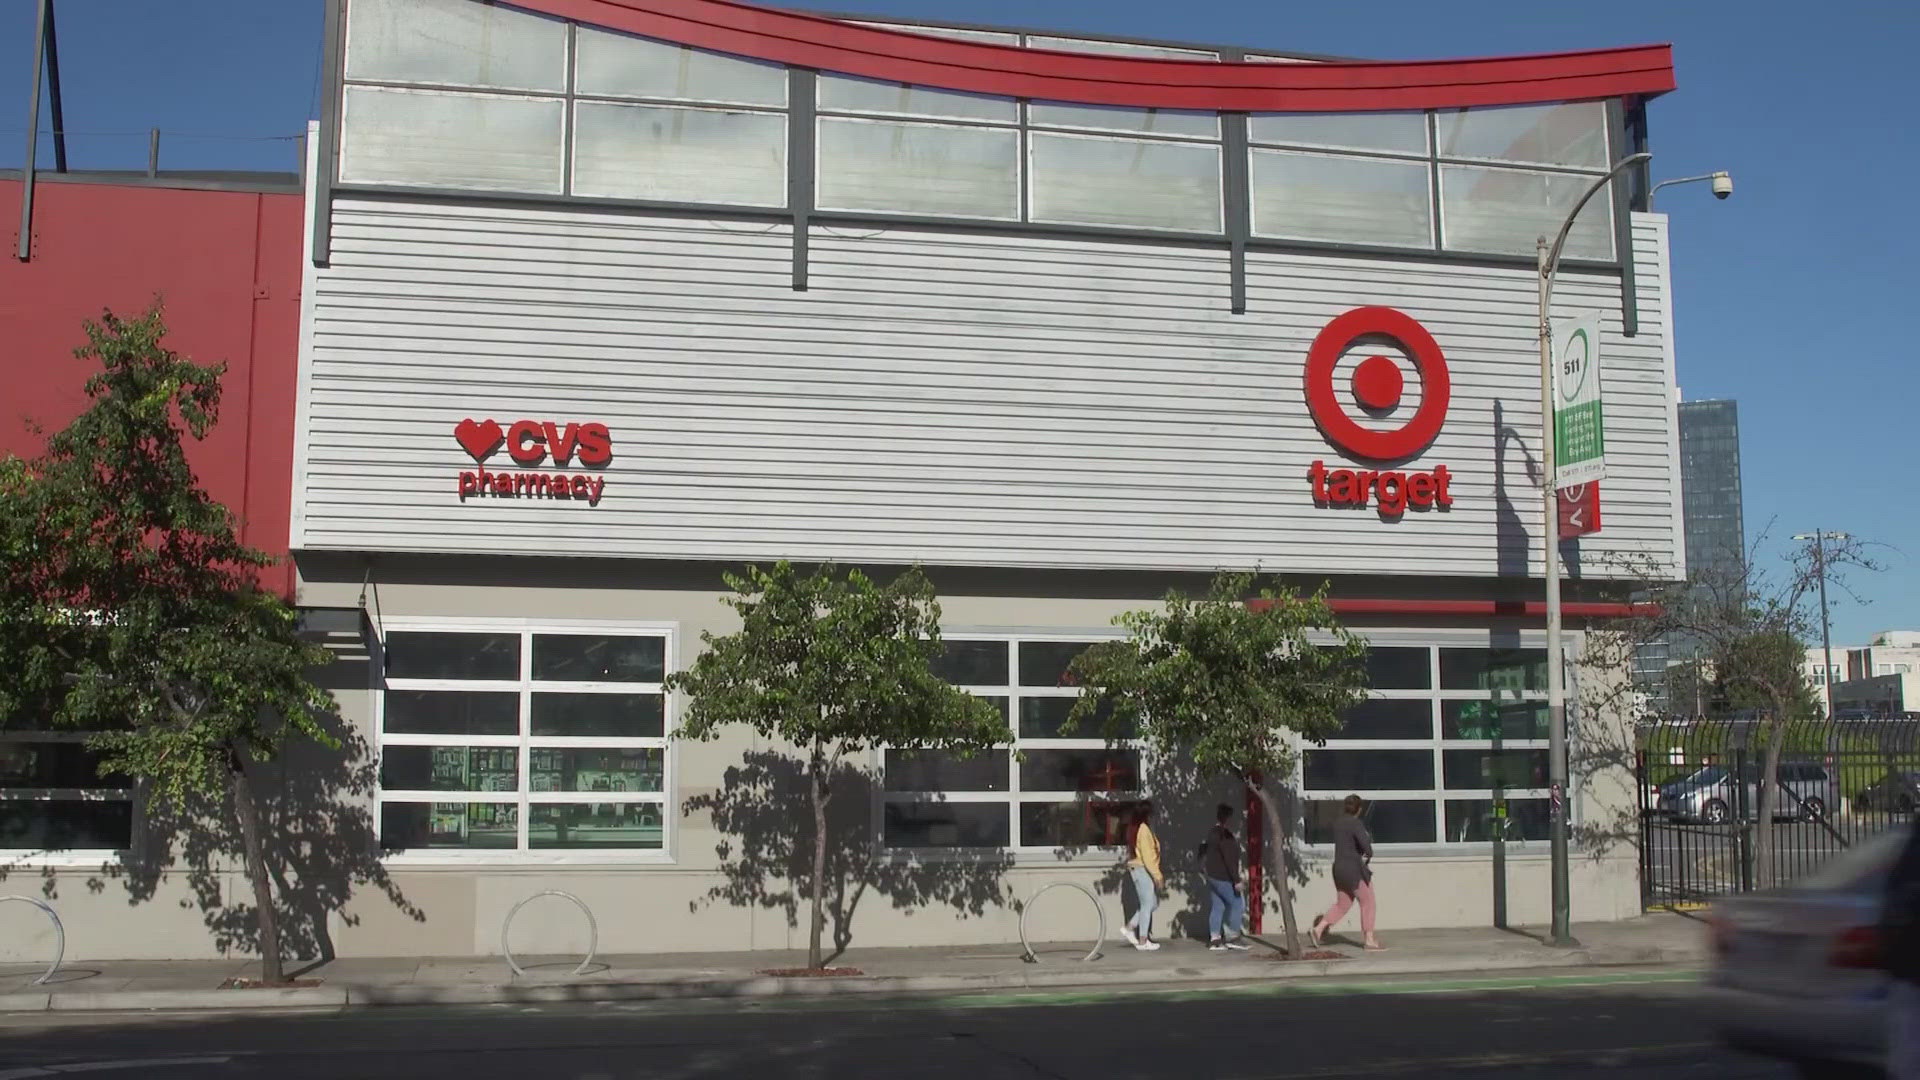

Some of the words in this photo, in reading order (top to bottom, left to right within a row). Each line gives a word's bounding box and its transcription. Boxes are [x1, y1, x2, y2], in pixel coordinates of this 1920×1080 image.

[1564, 357, 1580, 375] 511
[506, 420, 612, 465] CVS
[458, 463, 604, 505] pharmacy
[1308, 460, 1453, 520] target
